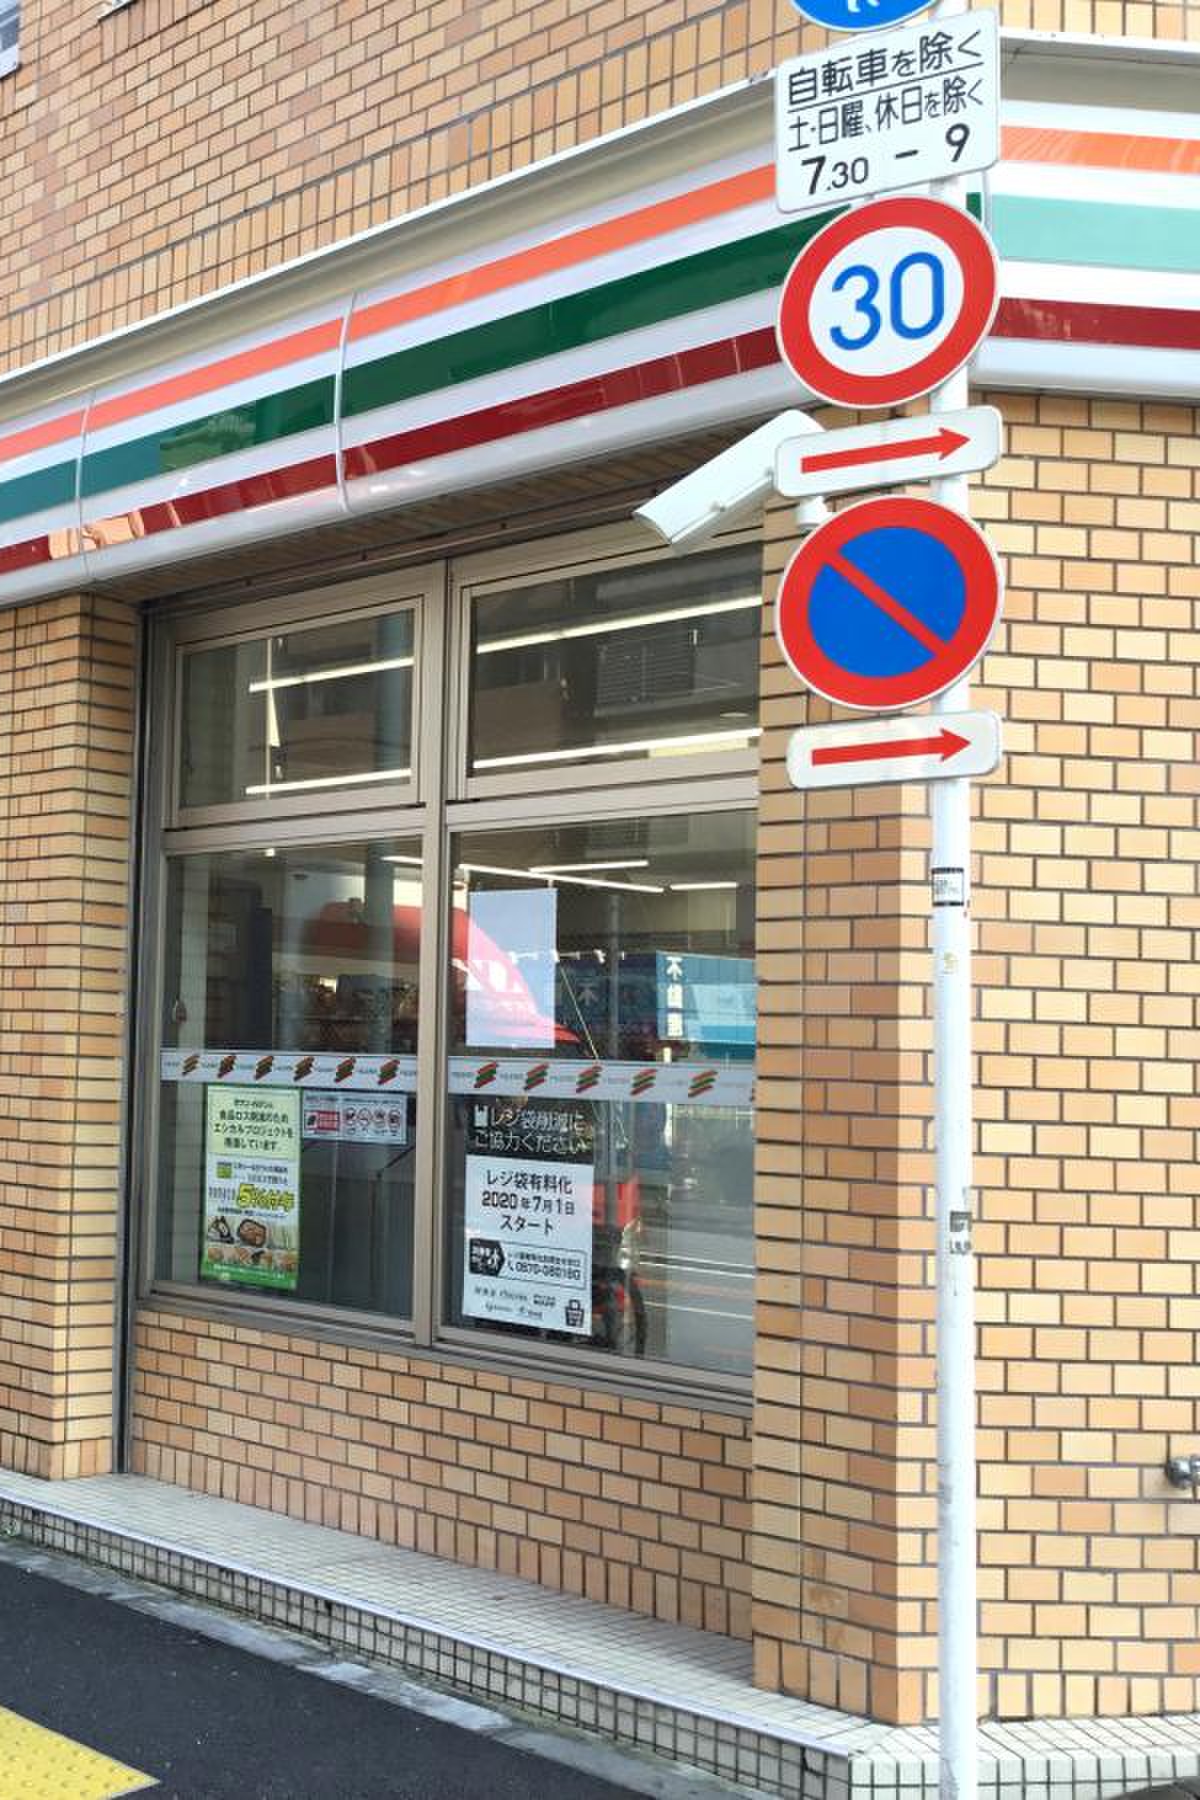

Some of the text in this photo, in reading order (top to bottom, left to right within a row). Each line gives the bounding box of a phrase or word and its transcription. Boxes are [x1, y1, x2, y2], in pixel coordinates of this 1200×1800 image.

[788, 30, 982, 106] 自転車を除く
[945, 123, 970, 162] 9
[830, 252, 945, 351] 30
[486, 1169, 573, 1194] レジ袋有料化
[482, 1190, 575, 1215] 2020年7月1日
[500, 1215, 554, 1236] スタート
